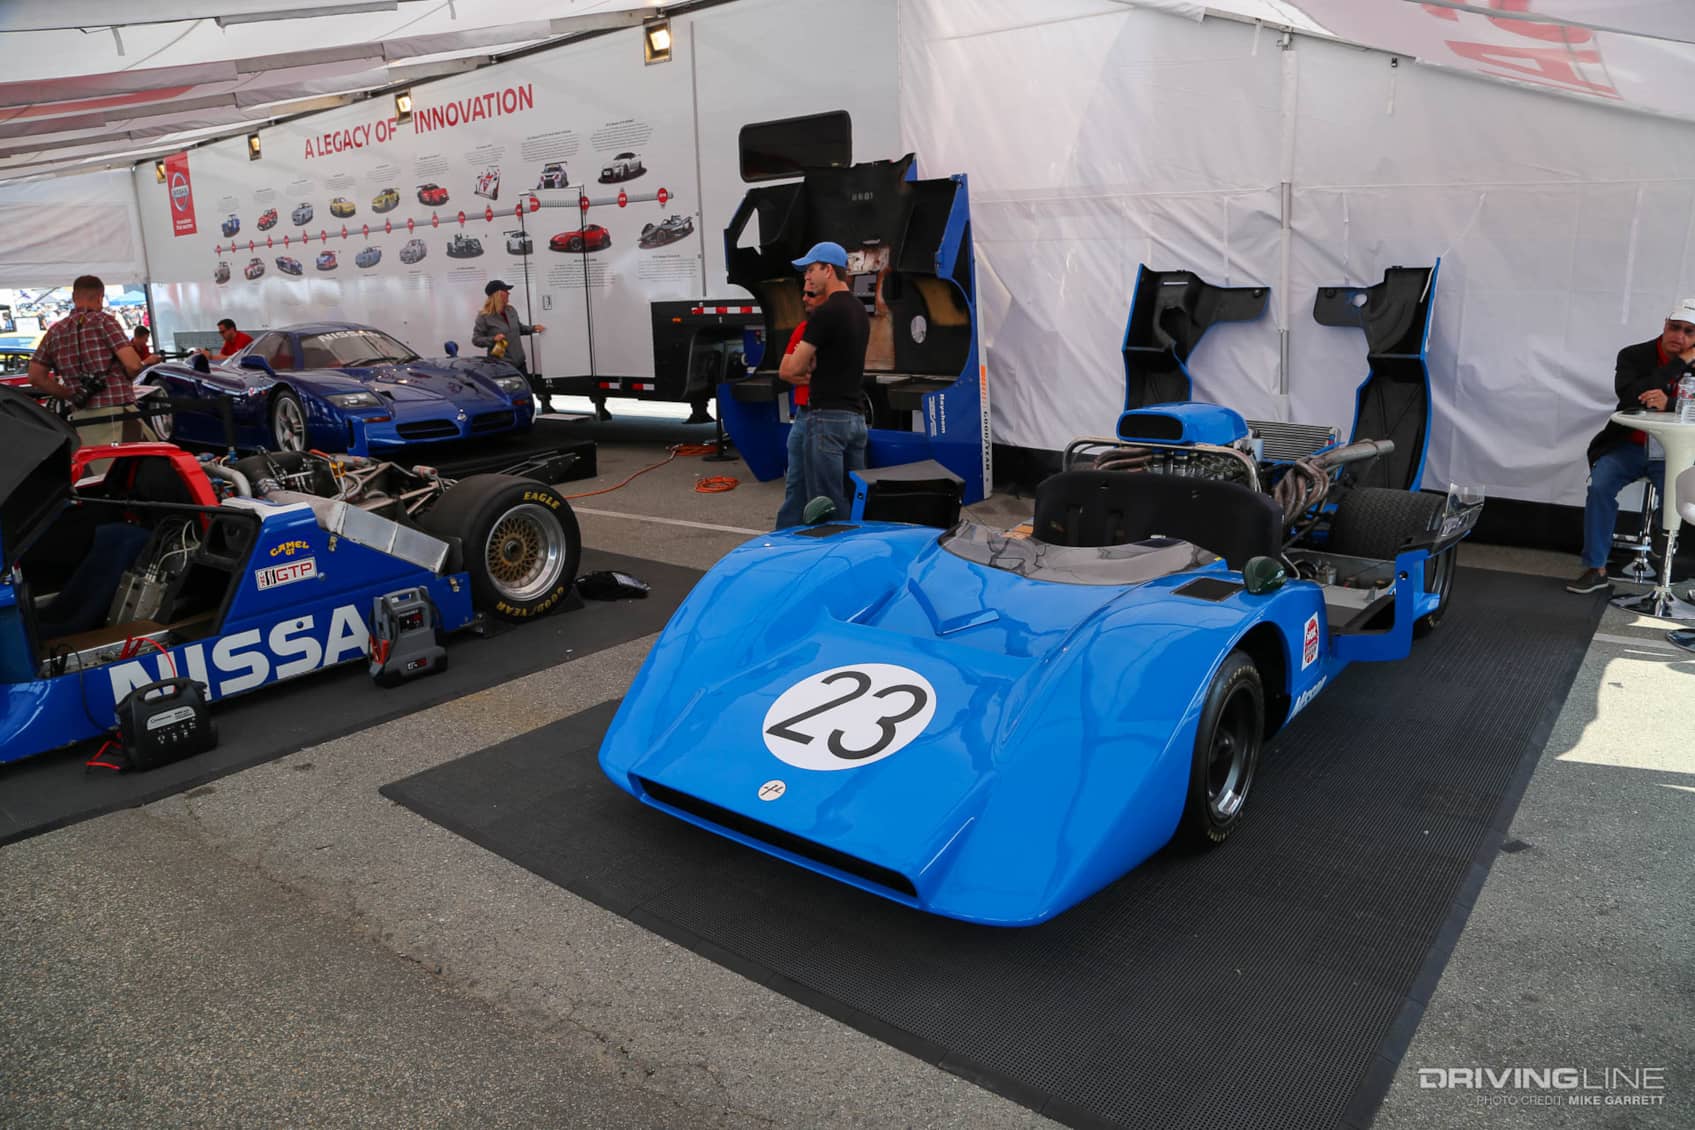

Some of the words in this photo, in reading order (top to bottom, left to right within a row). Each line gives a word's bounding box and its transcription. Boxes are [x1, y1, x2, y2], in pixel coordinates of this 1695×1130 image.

[304, 138, 315, 160] A
[317, 123, 372, 157] LEGACY
[375, 117, 397, 143] OF
[414, 83, 534, 135] INNOVATION
[982, 410, 992, 471] GOODYEAR
[523, 491, 561, 510] EAGLE
[269, 541, 309, 557] CAMEL
[276, 562, 312, 583] GTP
[496, 586, 565, 617] GOODYEAR
[108, 604, 372, 705] NISSA
[765, 670, 928, 760] 23
